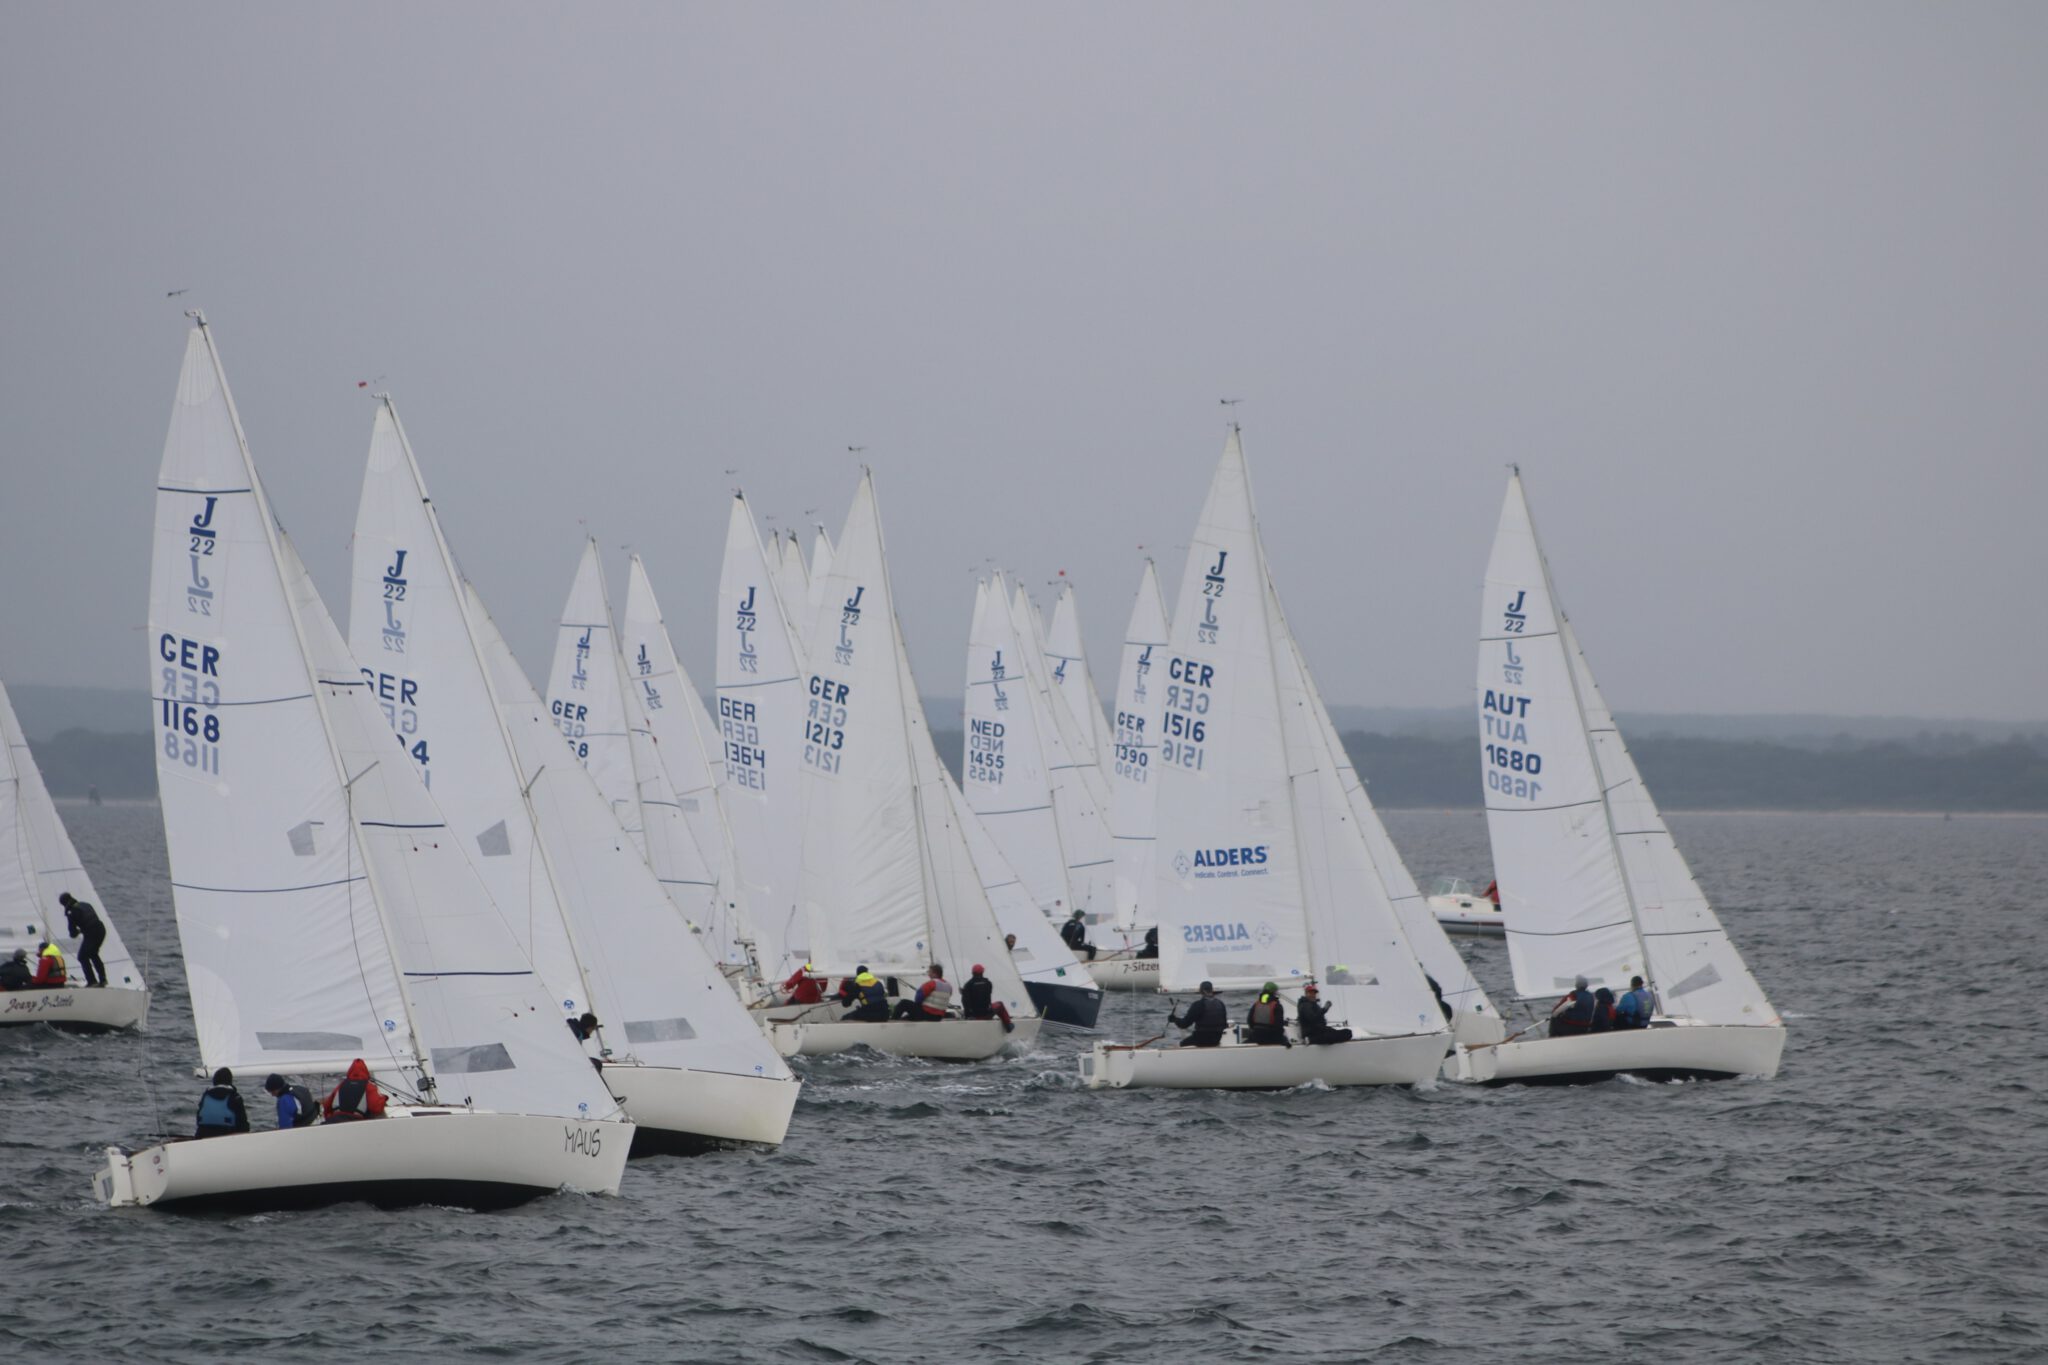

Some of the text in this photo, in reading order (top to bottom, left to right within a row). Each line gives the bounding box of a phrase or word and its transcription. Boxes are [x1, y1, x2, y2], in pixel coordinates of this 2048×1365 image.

[193, 497, 218, 528] J
[190, 537, 215, 555] 22
[387, 551, 407, 577] J
[1210, 551, 1227, 576] J
[383, 584, 406, 601] 22
[740, 587, 756, 611] J
[847, 587, 865, 608] J
[1203, 582, 1224, 597] 22
[1507, 591, 1526, 612] J
[736, 616, 756, 631] 22
[841, 612, 860, 626] 22
[1504, 620, 1524, 633] 22
[580, 627, 591, 644] J
[160, 633, 220, 677] GER
[638, 644, 646, 660] J
[992, 651, 1001, 667] J
[1140, 646, 1152, 661] J
[640, 664, 652, 675] 22
[993, 670, 1005, 680] 22
[1056, 659, 1066, 672] J
[1169, 658, 1214, 688] GER
[809, 676, 850, 705] GER
[552, 700, 588, 721] GER
[720, 697, 756, 723] GER
[1483, 689, 1531, 718] AUT
[163, 699, 220, 743] 1168
[971, 719, 1005, 738] NED
[1118, 711, 1145, 733] GER
[1163, 712, 1205, 743] 1516
[805, 721, 844, 750] 1213
[396, 734, 430, 765] 4
[724, 741, 765, 768] 1364
[970, 750, 1004, 769] 1455
[1115, 744, 1148, 767] 1390
[1486, 744, 1541, 775] 1680
[1194, 846, 1267, 867] ALDERS
[564, 1125, 601, 1157] MAUS
